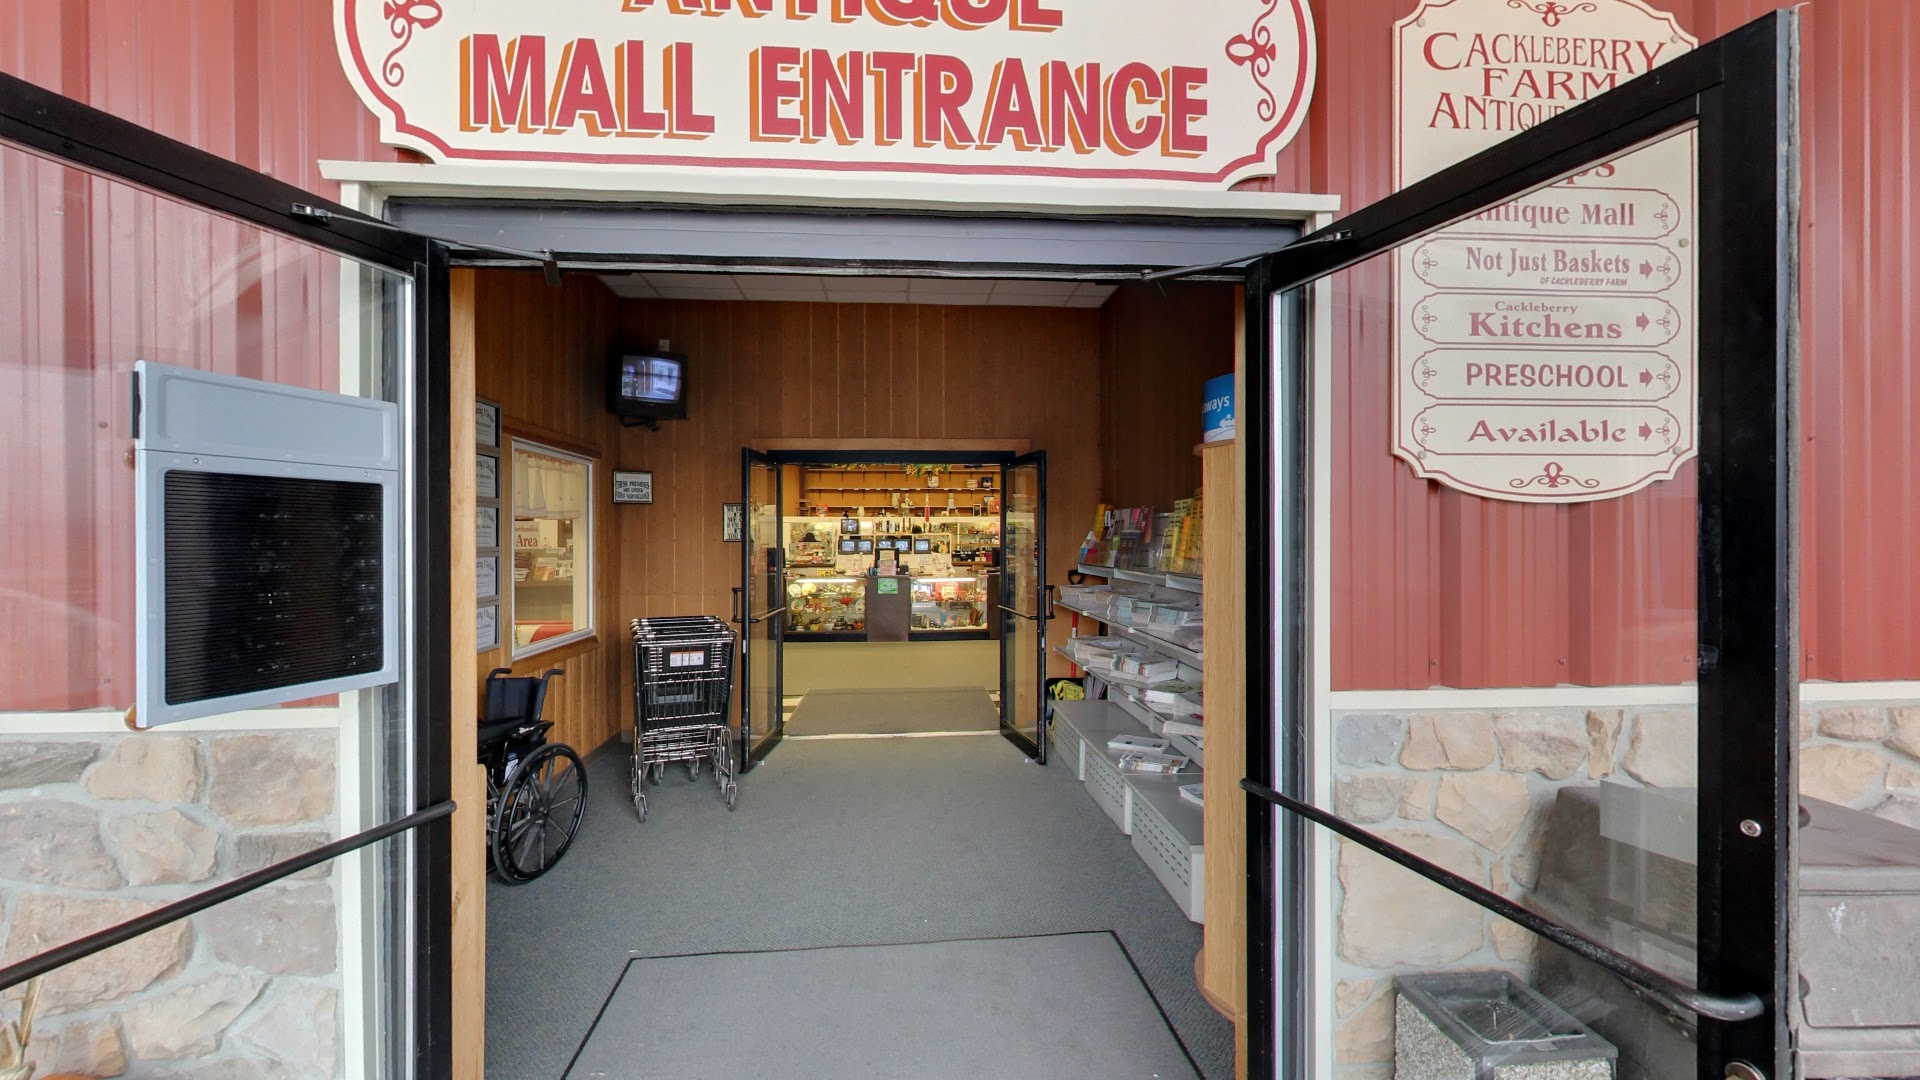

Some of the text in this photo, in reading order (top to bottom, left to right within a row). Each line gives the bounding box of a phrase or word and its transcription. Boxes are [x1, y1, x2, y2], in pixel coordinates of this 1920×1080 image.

[1423, 32, 1667, 74] CACKLEBERRY
[460, 33, 1208, 158] MALL ENTRANCE
[1482, 67, 1617, 100] FARM
[1581, 203, 1635, 226] Mall
[1466, 247, 1630, 277] Not Just Baskets
[1540, 276, 1627, 287] OF CACKLEBERRY FARM
[1494, 301, 1578, 315] Cackleberry
[1468, 312, 1622, 339] Kitchens
[1466, 362, 1628, 387] PRESCHOOL
[1467, 419, 1626, 443] Available
[516, 534, 538, 547] Area
